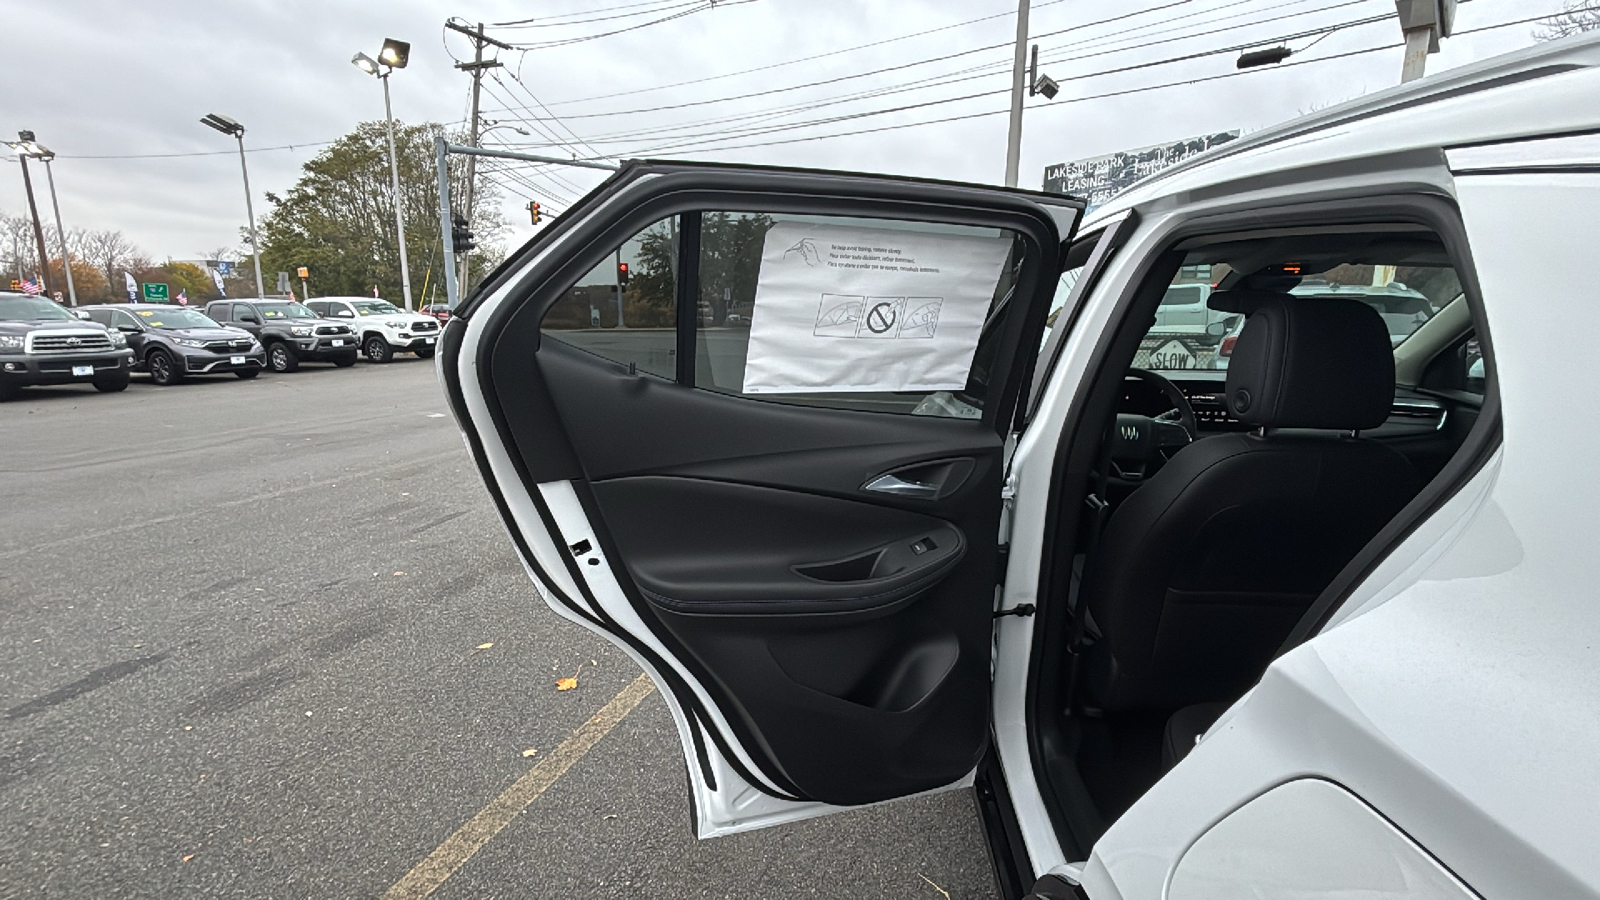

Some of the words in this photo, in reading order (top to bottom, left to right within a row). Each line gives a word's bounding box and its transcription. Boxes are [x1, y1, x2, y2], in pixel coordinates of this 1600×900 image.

[1047, 162, 1094, 181] LAKESIDE
[1096, 156, 1125, 171] PARK
[1062, 175, 1105, 193] LEASING
[1154, 352, 1190, 369] SLOW
